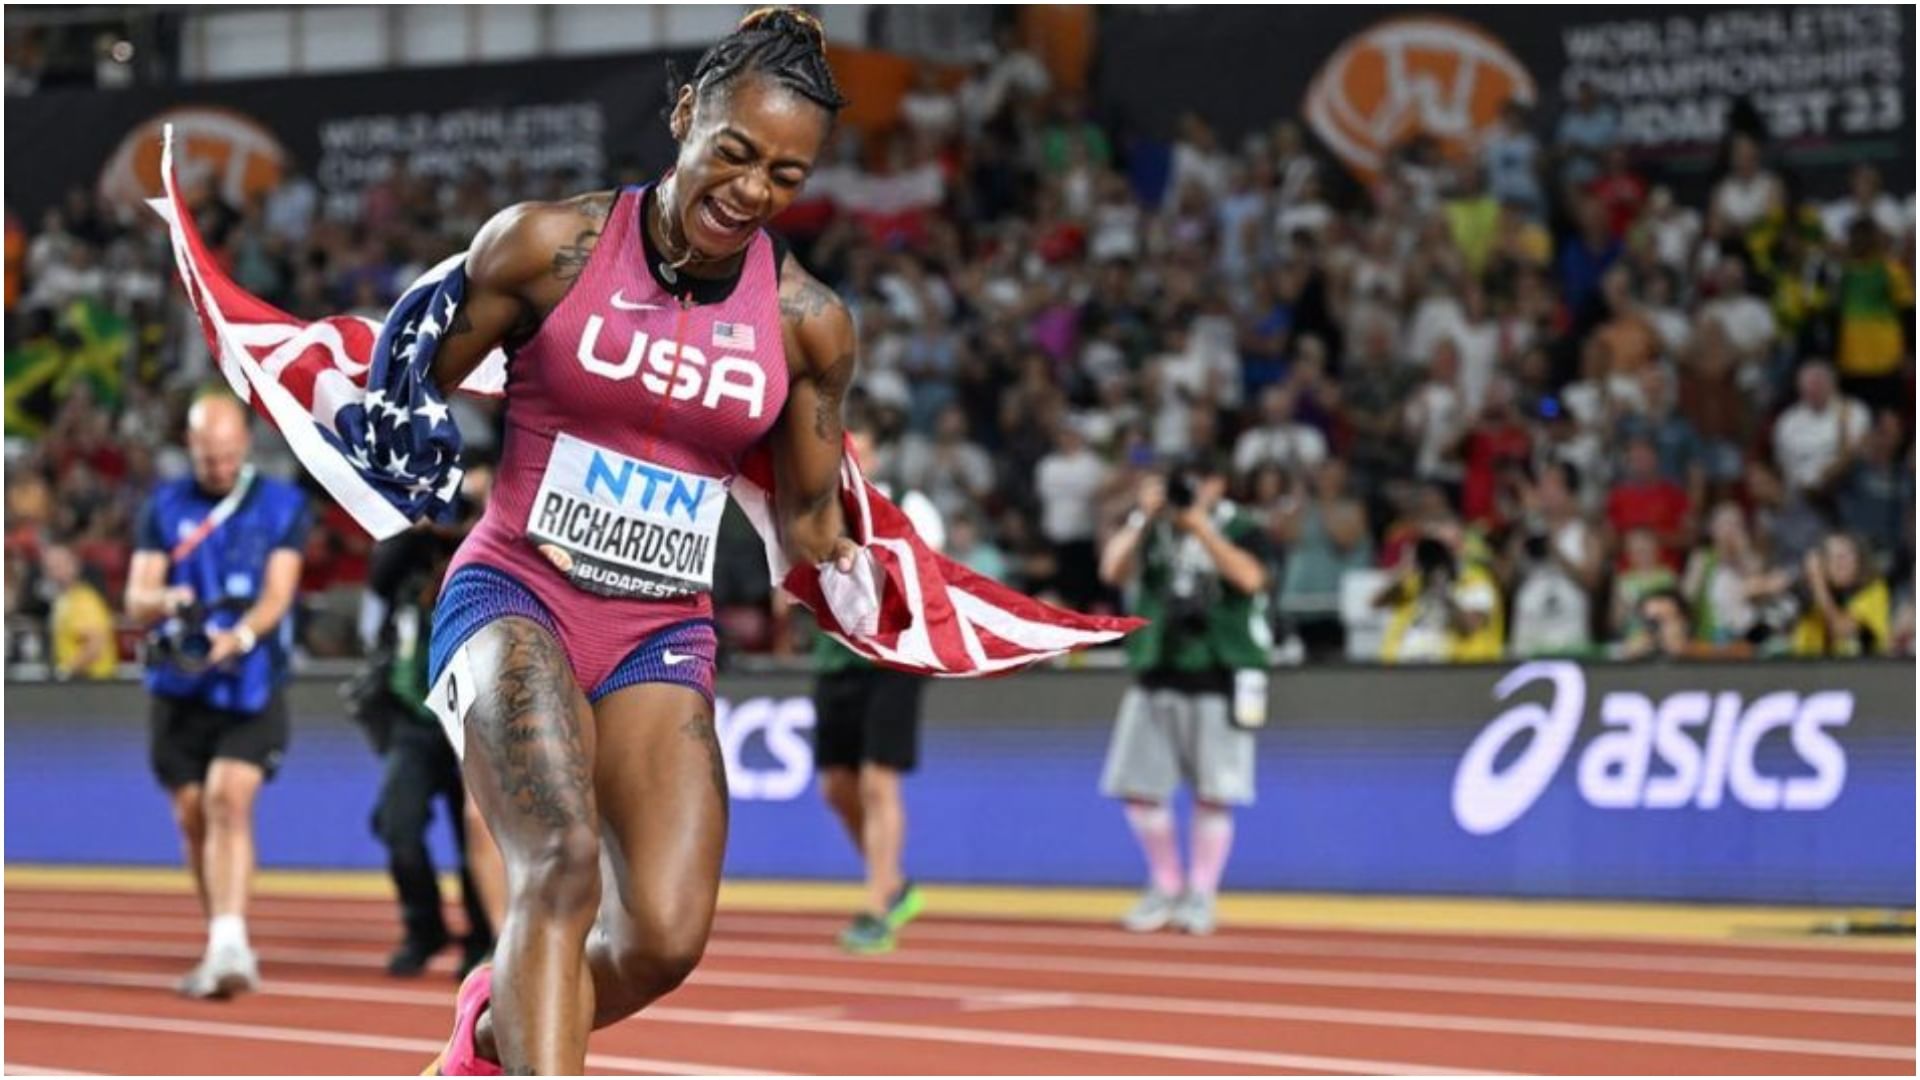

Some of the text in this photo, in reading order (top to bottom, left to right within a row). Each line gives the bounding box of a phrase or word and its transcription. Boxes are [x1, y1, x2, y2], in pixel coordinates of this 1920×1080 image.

[1562, 5, 1902, 62] WORLD ATHLETICS
[1840, 86, 1903, 133] 23
[577, 313, 767, 419] USA
[585, 450, 706, 523] NTN
[537, 492, 710, 577] RICHARDSON
[577, 563, 677, 598] BUDAPEST
